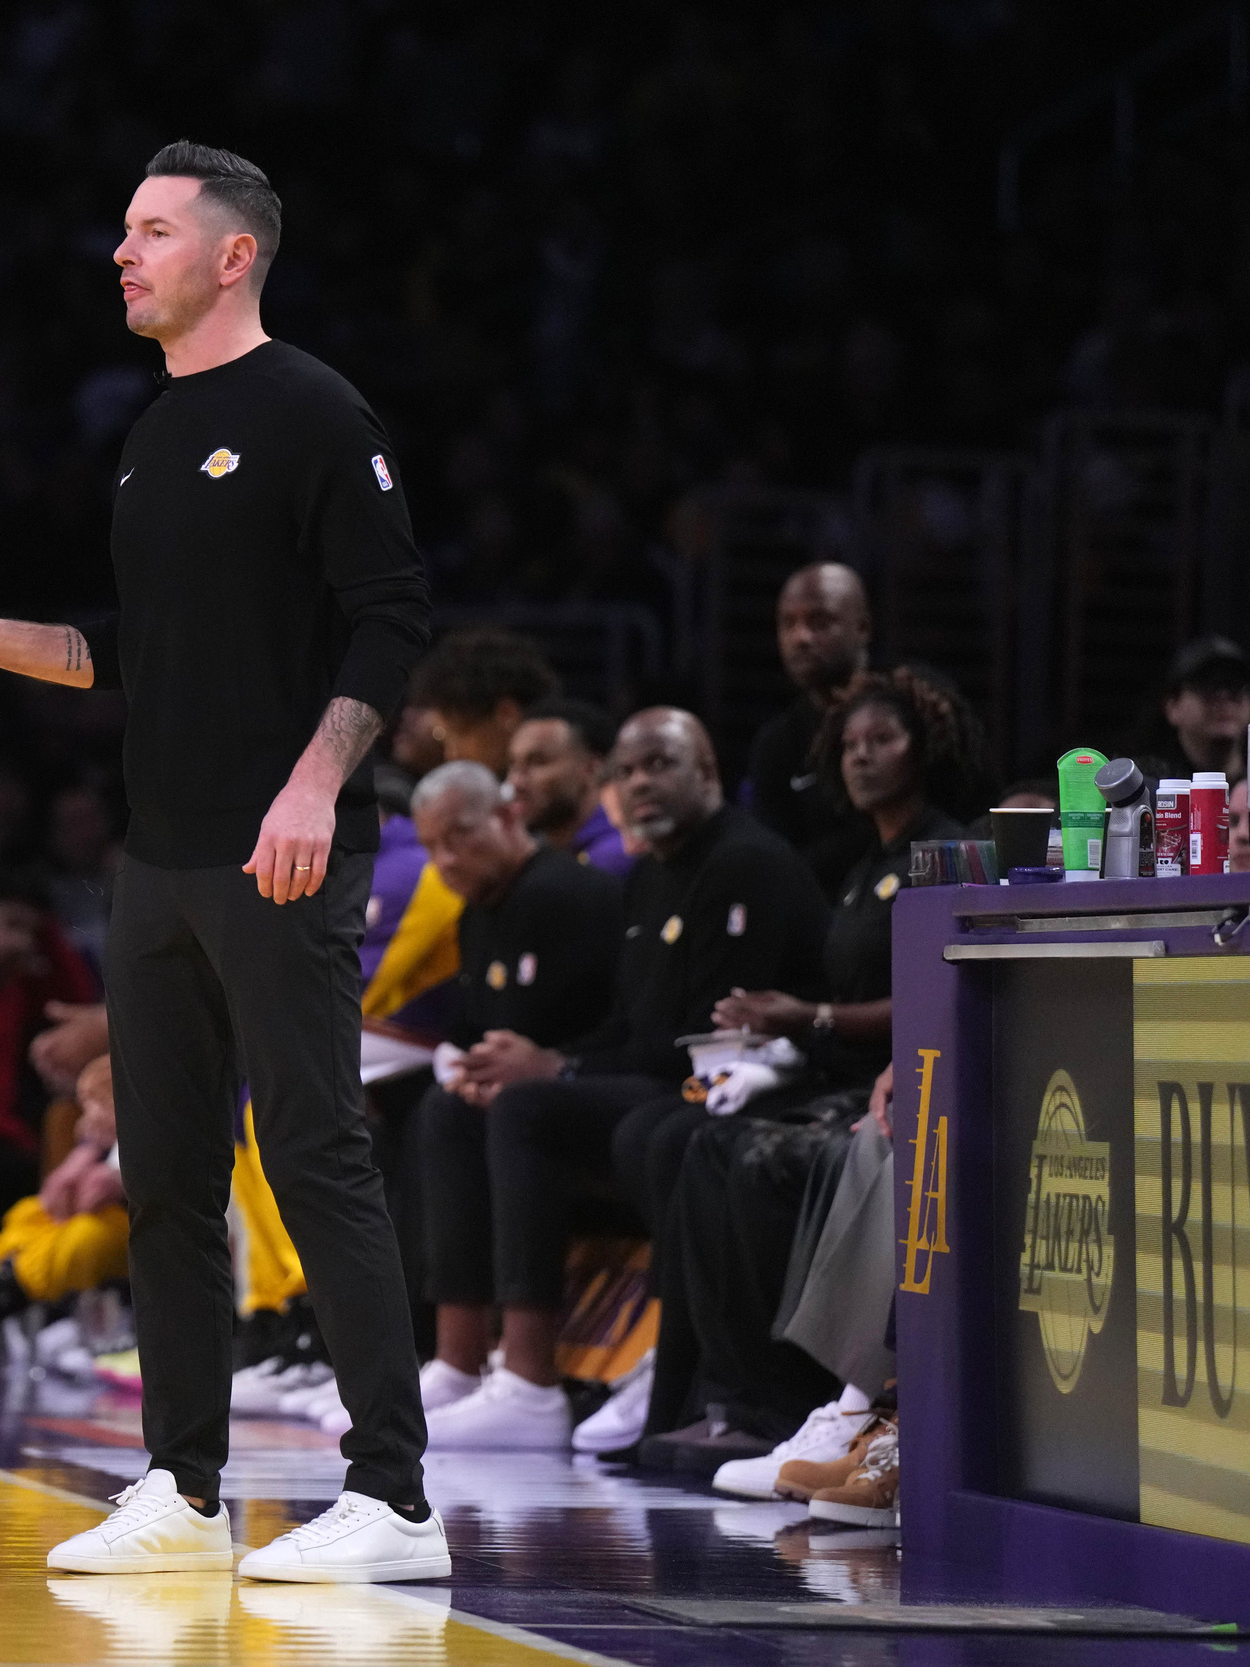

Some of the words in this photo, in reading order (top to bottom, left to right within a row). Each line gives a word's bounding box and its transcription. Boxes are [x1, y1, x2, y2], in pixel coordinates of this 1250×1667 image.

[1023, 1154, 1106, 1315] LAKERS
[1049, 1154, 1064, 1179] LOS
[1064, 1155, 1106, 1181] ANGELES
[1157, 1080, 1250, 1420] BU
